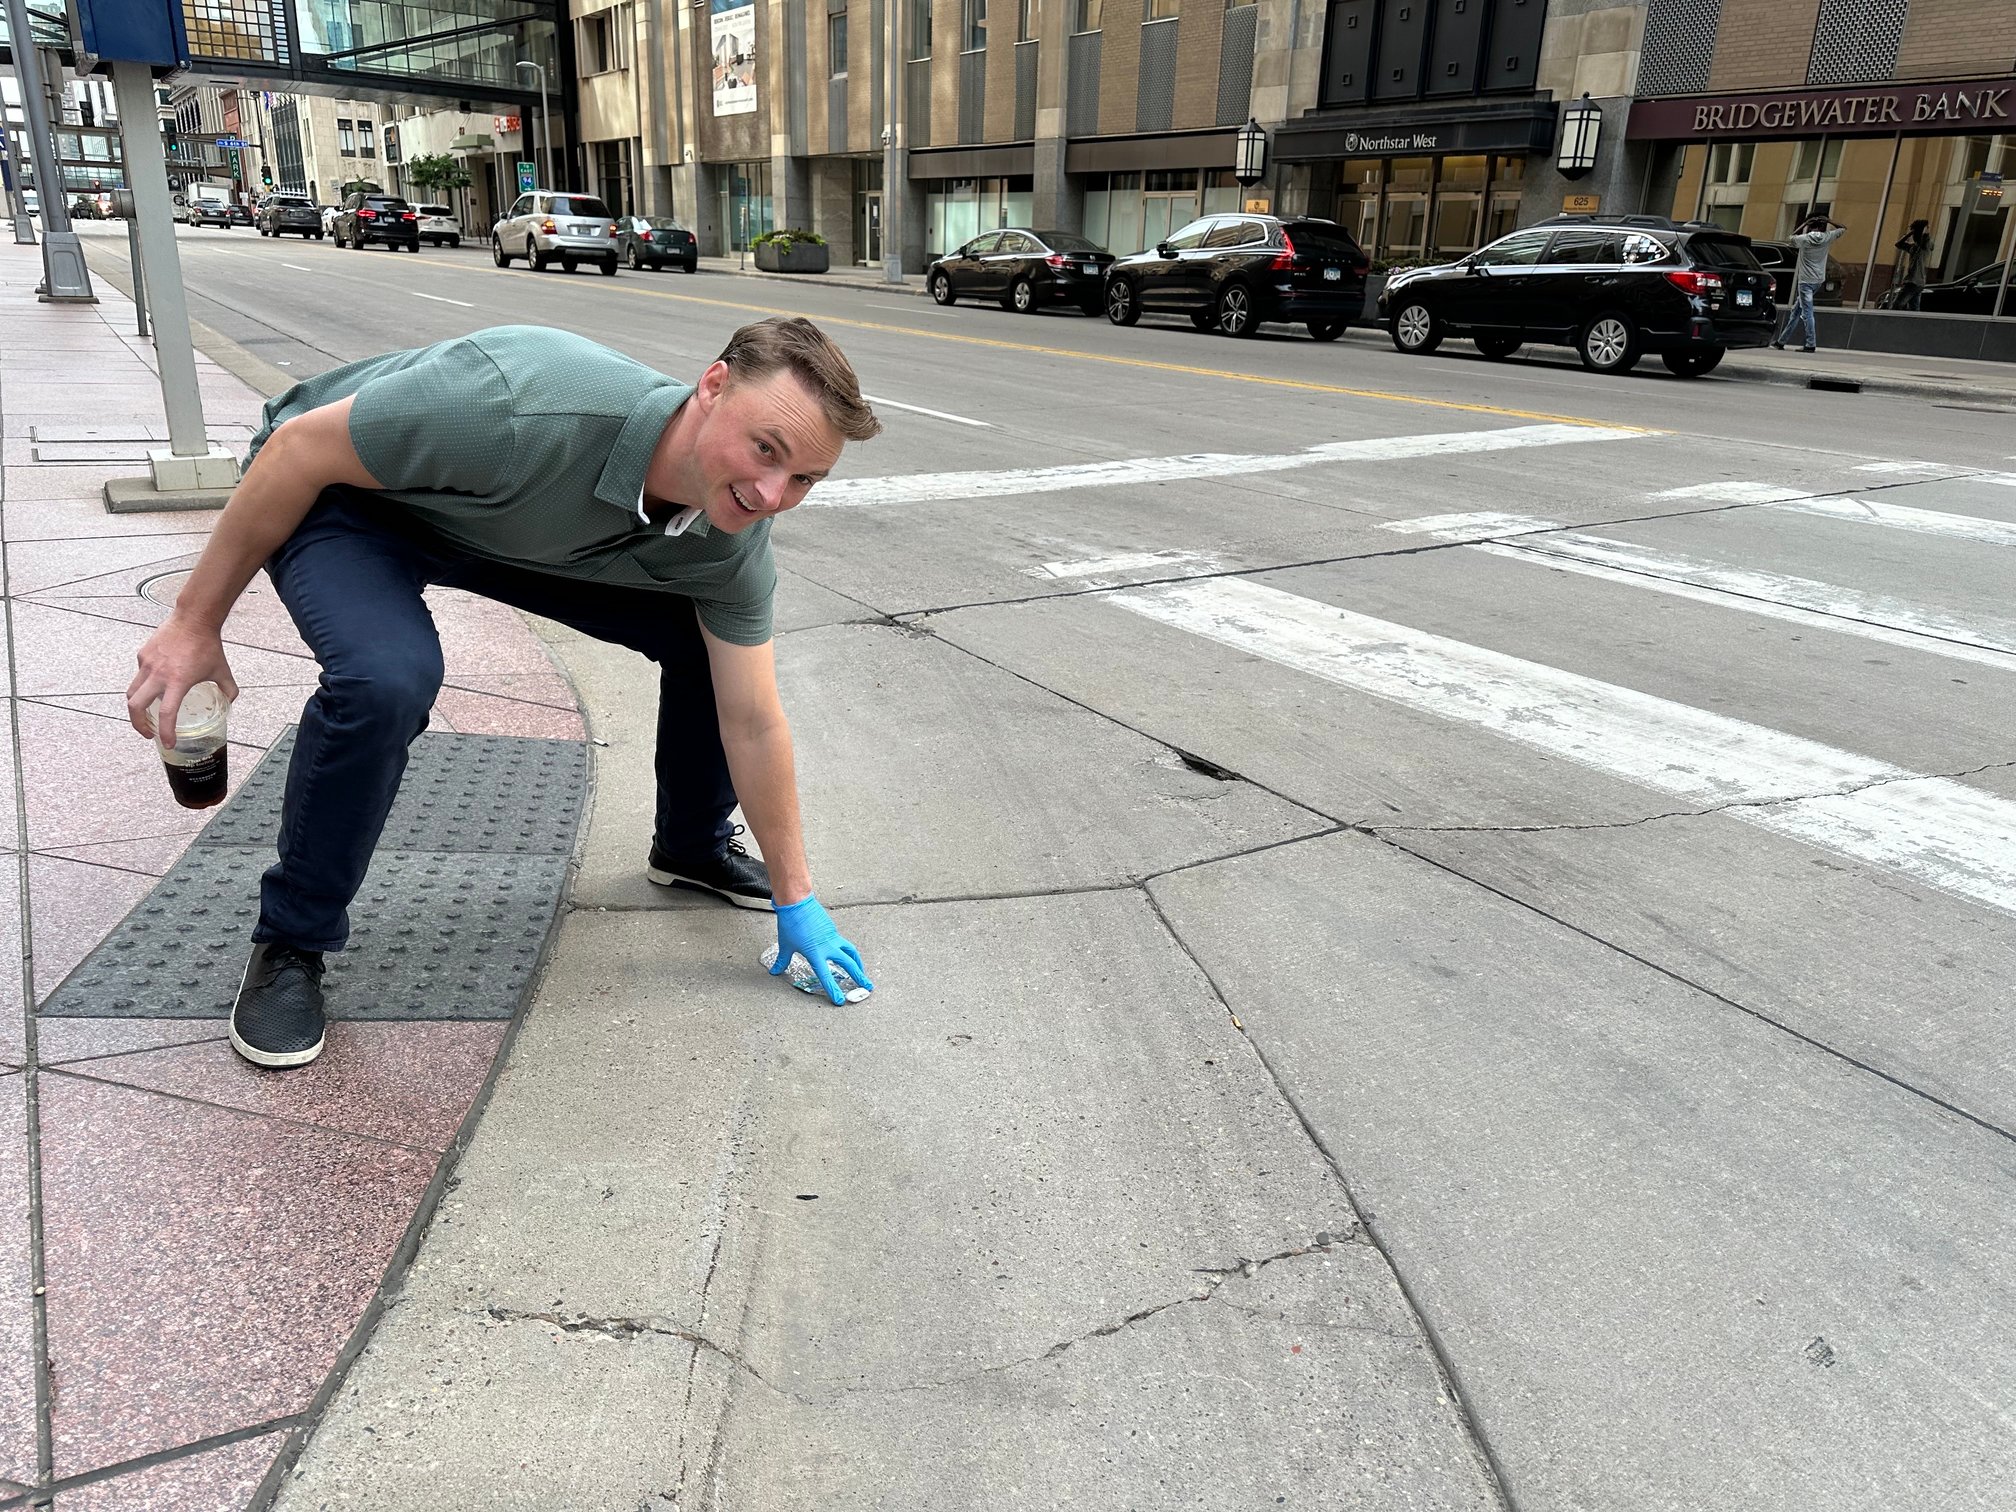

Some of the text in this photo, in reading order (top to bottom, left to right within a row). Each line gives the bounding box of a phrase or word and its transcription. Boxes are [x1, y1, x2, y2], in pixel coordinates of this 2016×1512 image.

[1692, 90, 2009, 131] BRIDGEWATER BANK
[1360, 134, 1437, 150] Northstar West
[231, 151, 239, 177] PARK
[522, 176, 532, 184] 94
[1574, 197, 1589, 206] 625
